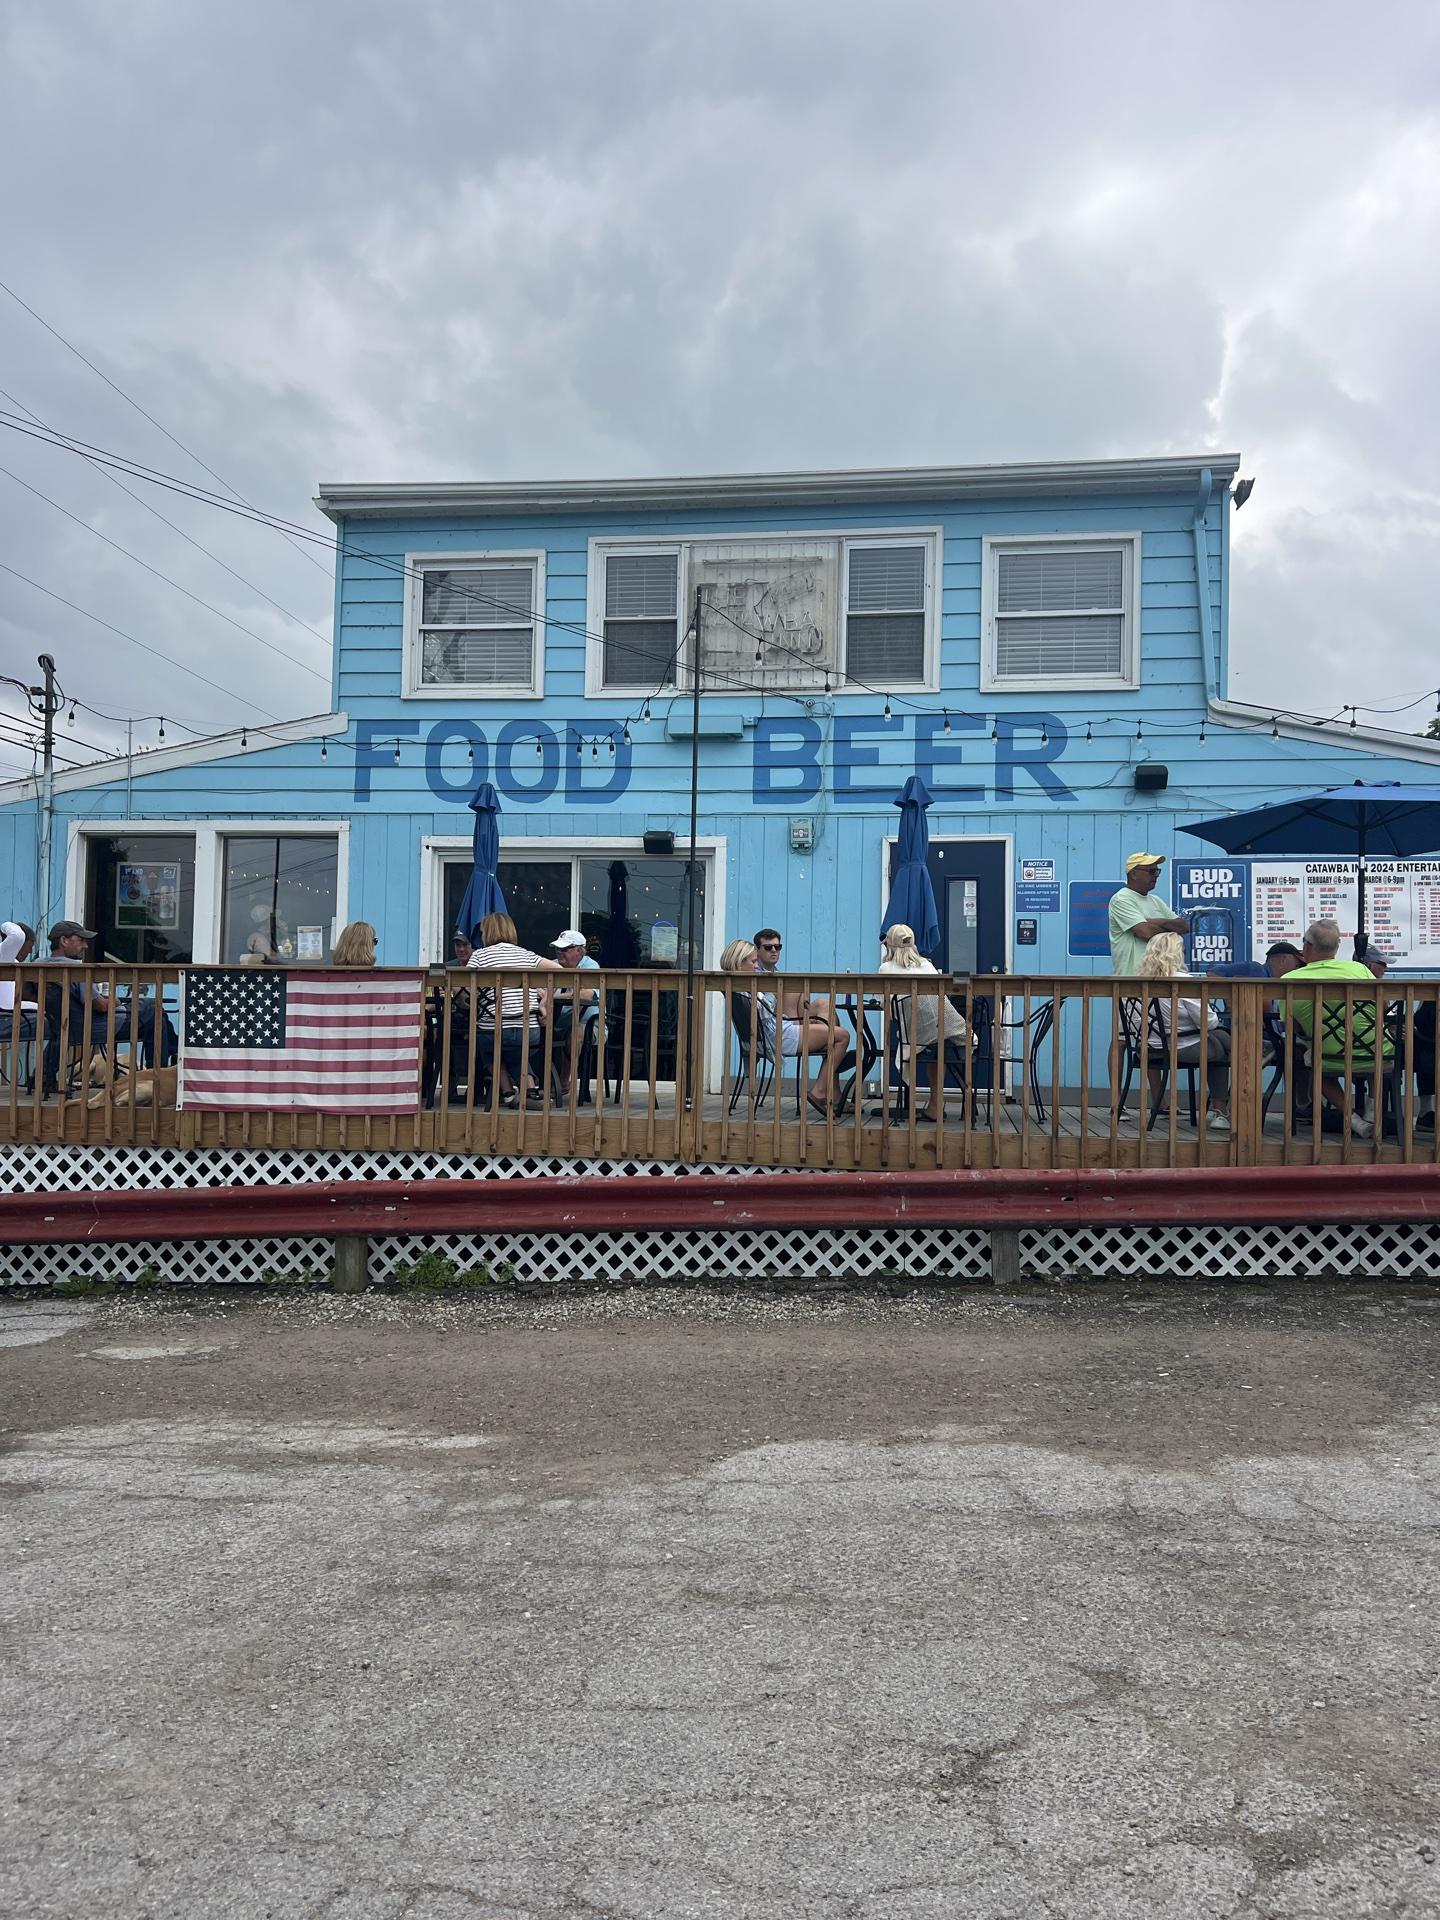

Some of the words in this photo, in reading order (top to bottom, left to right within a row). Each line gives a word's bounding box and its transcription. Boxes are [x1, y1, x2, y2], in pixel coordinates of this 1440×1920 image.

[354, 717, 632, 804] FOOD
[752, 711, 1079, 805] BEER
[938, 850, 944, 859] 8
[1305, 863, 1349, 873] CATAWBA
[1370, 863, 1394, 872] 2024
[1190, 868, 1233, 883] BUD
[1256, 877, 1278, 885] JANUARY
[1307, 876, 1332, 884] FEBRUARY
[1181, 883, 1242, 898] LIGHT
[1195, 935, 1229, 949] BUD
[1191, 948, 1233, 962] LIGHT
